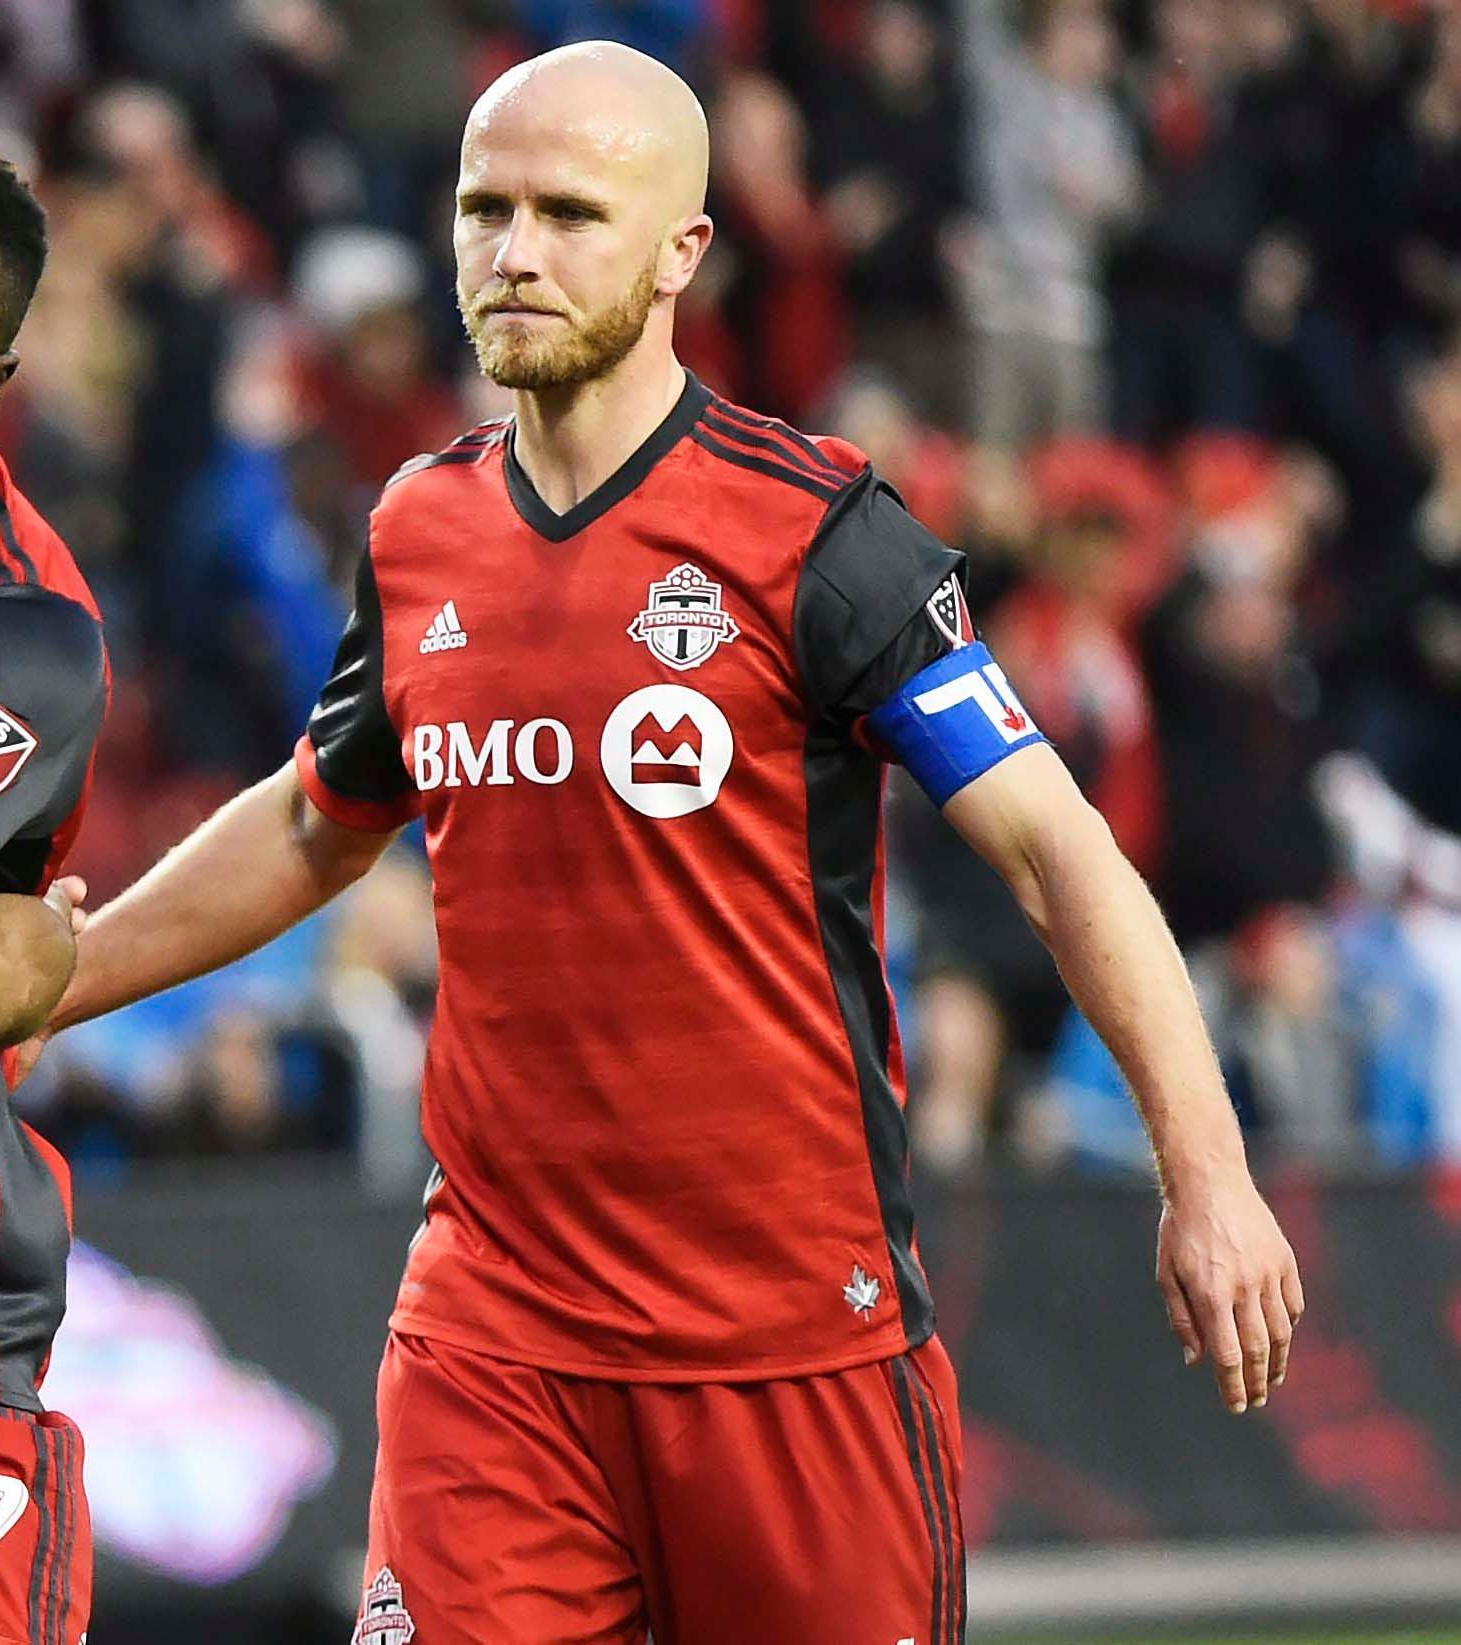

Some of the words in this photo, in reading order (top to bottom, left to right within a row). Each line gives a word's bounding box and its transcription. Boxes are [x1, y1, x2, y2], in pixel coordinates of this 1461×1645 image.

[645, 611, 722, 627] TORONTO
[419, 631, 468, 655] adidas
[414, 718, 573, 791] BMO
